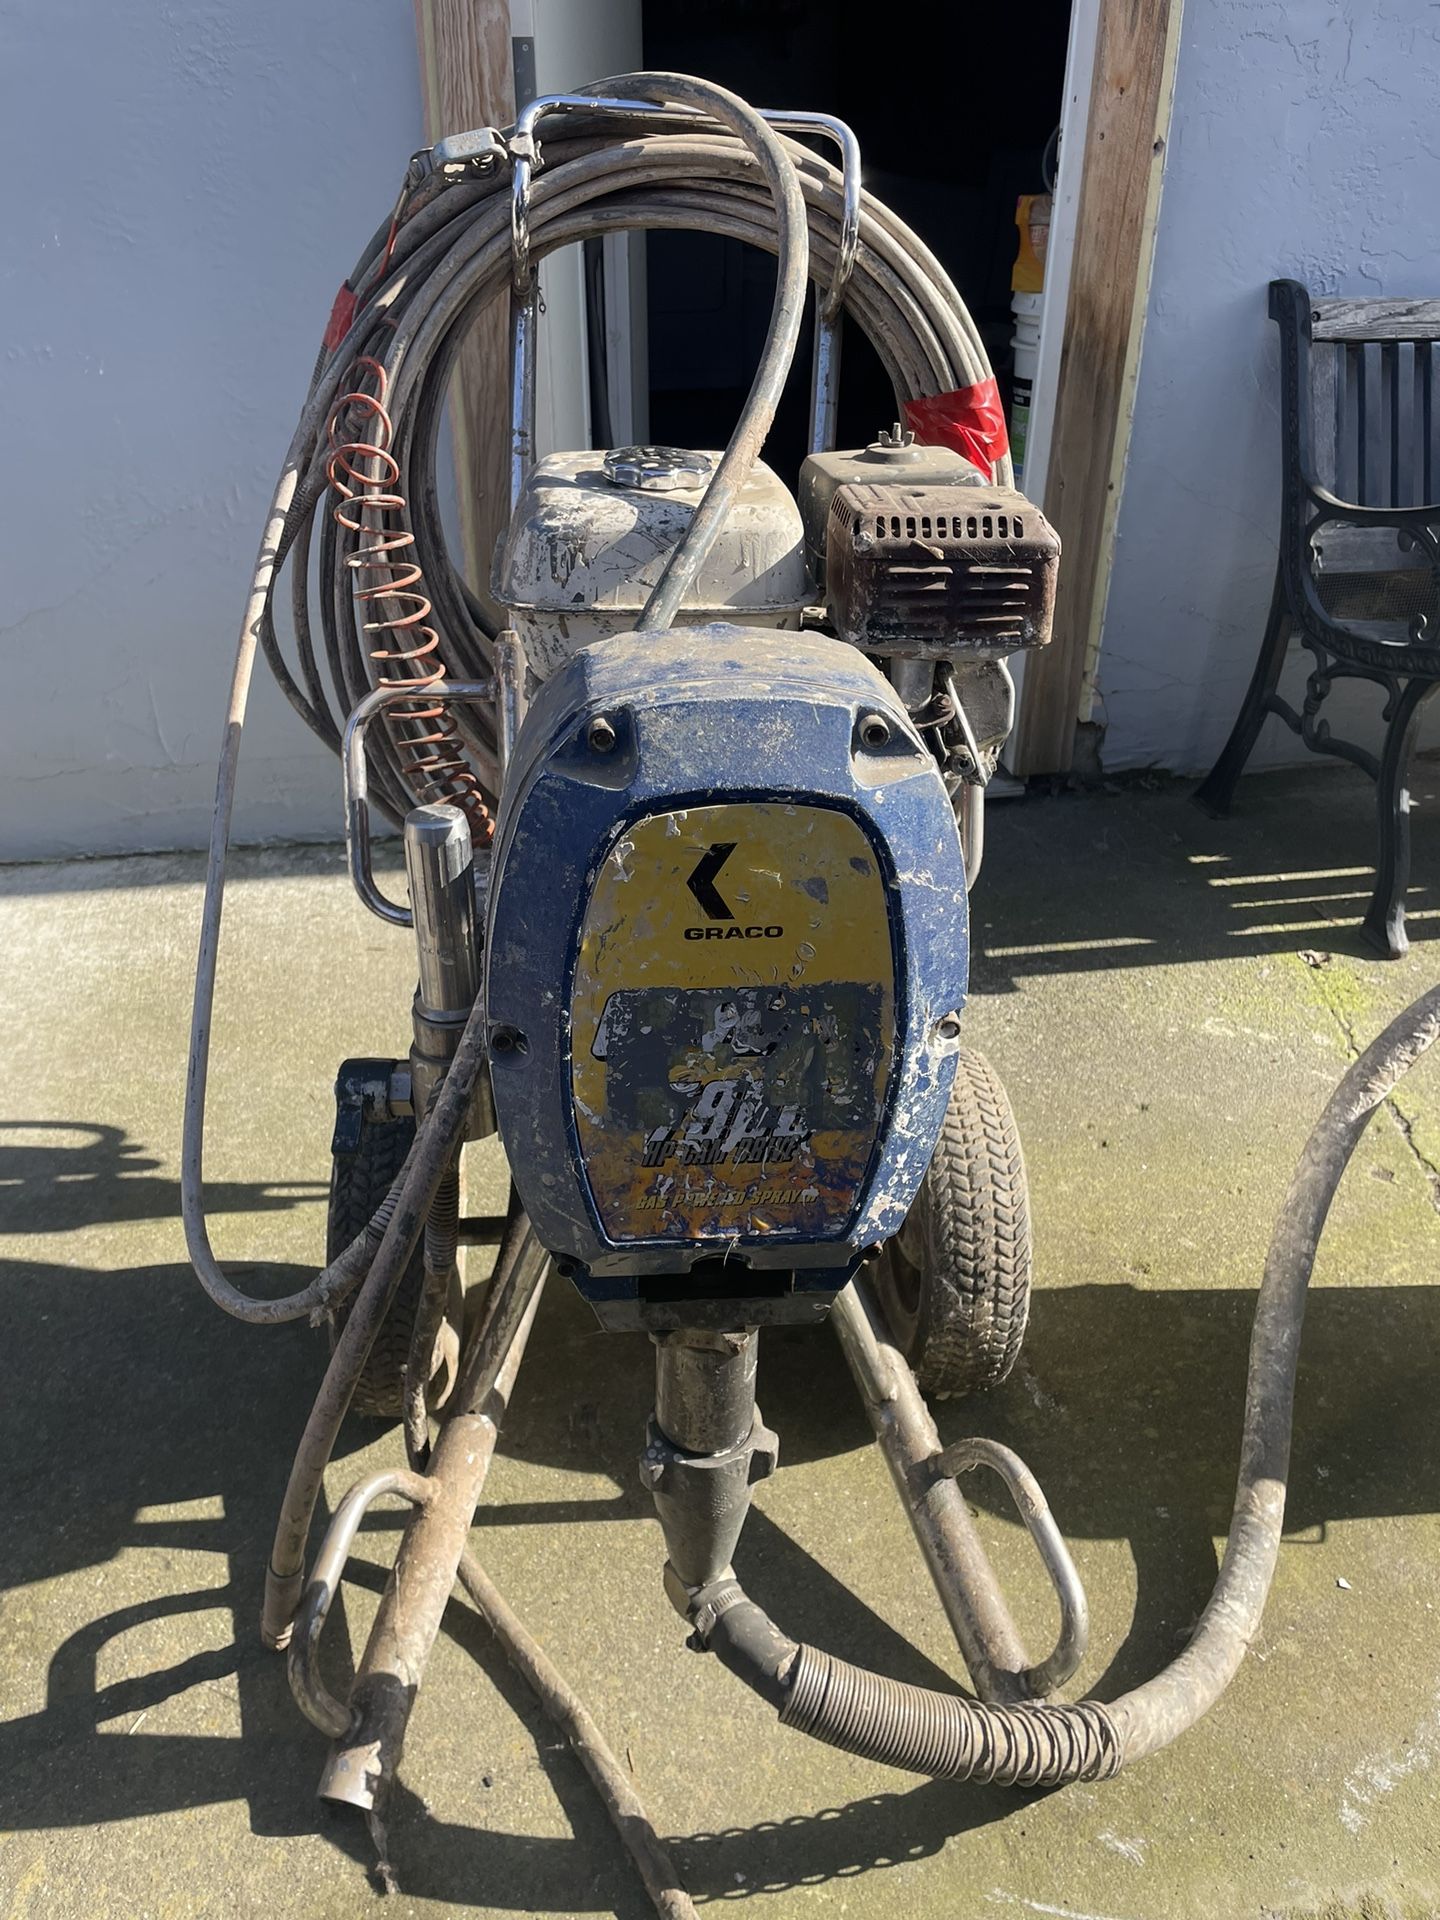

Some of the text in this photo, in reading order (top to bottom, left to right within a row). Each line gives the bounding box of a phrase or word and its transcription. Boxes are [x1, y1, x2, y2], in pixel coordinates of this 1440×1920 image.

[684, 926, 783, 940] GRACO
[641, 1141, 675, 1167] HP
[733, 1135, 801, 1163] DRIVE
[636, 1196, 668, 1210] GAS
